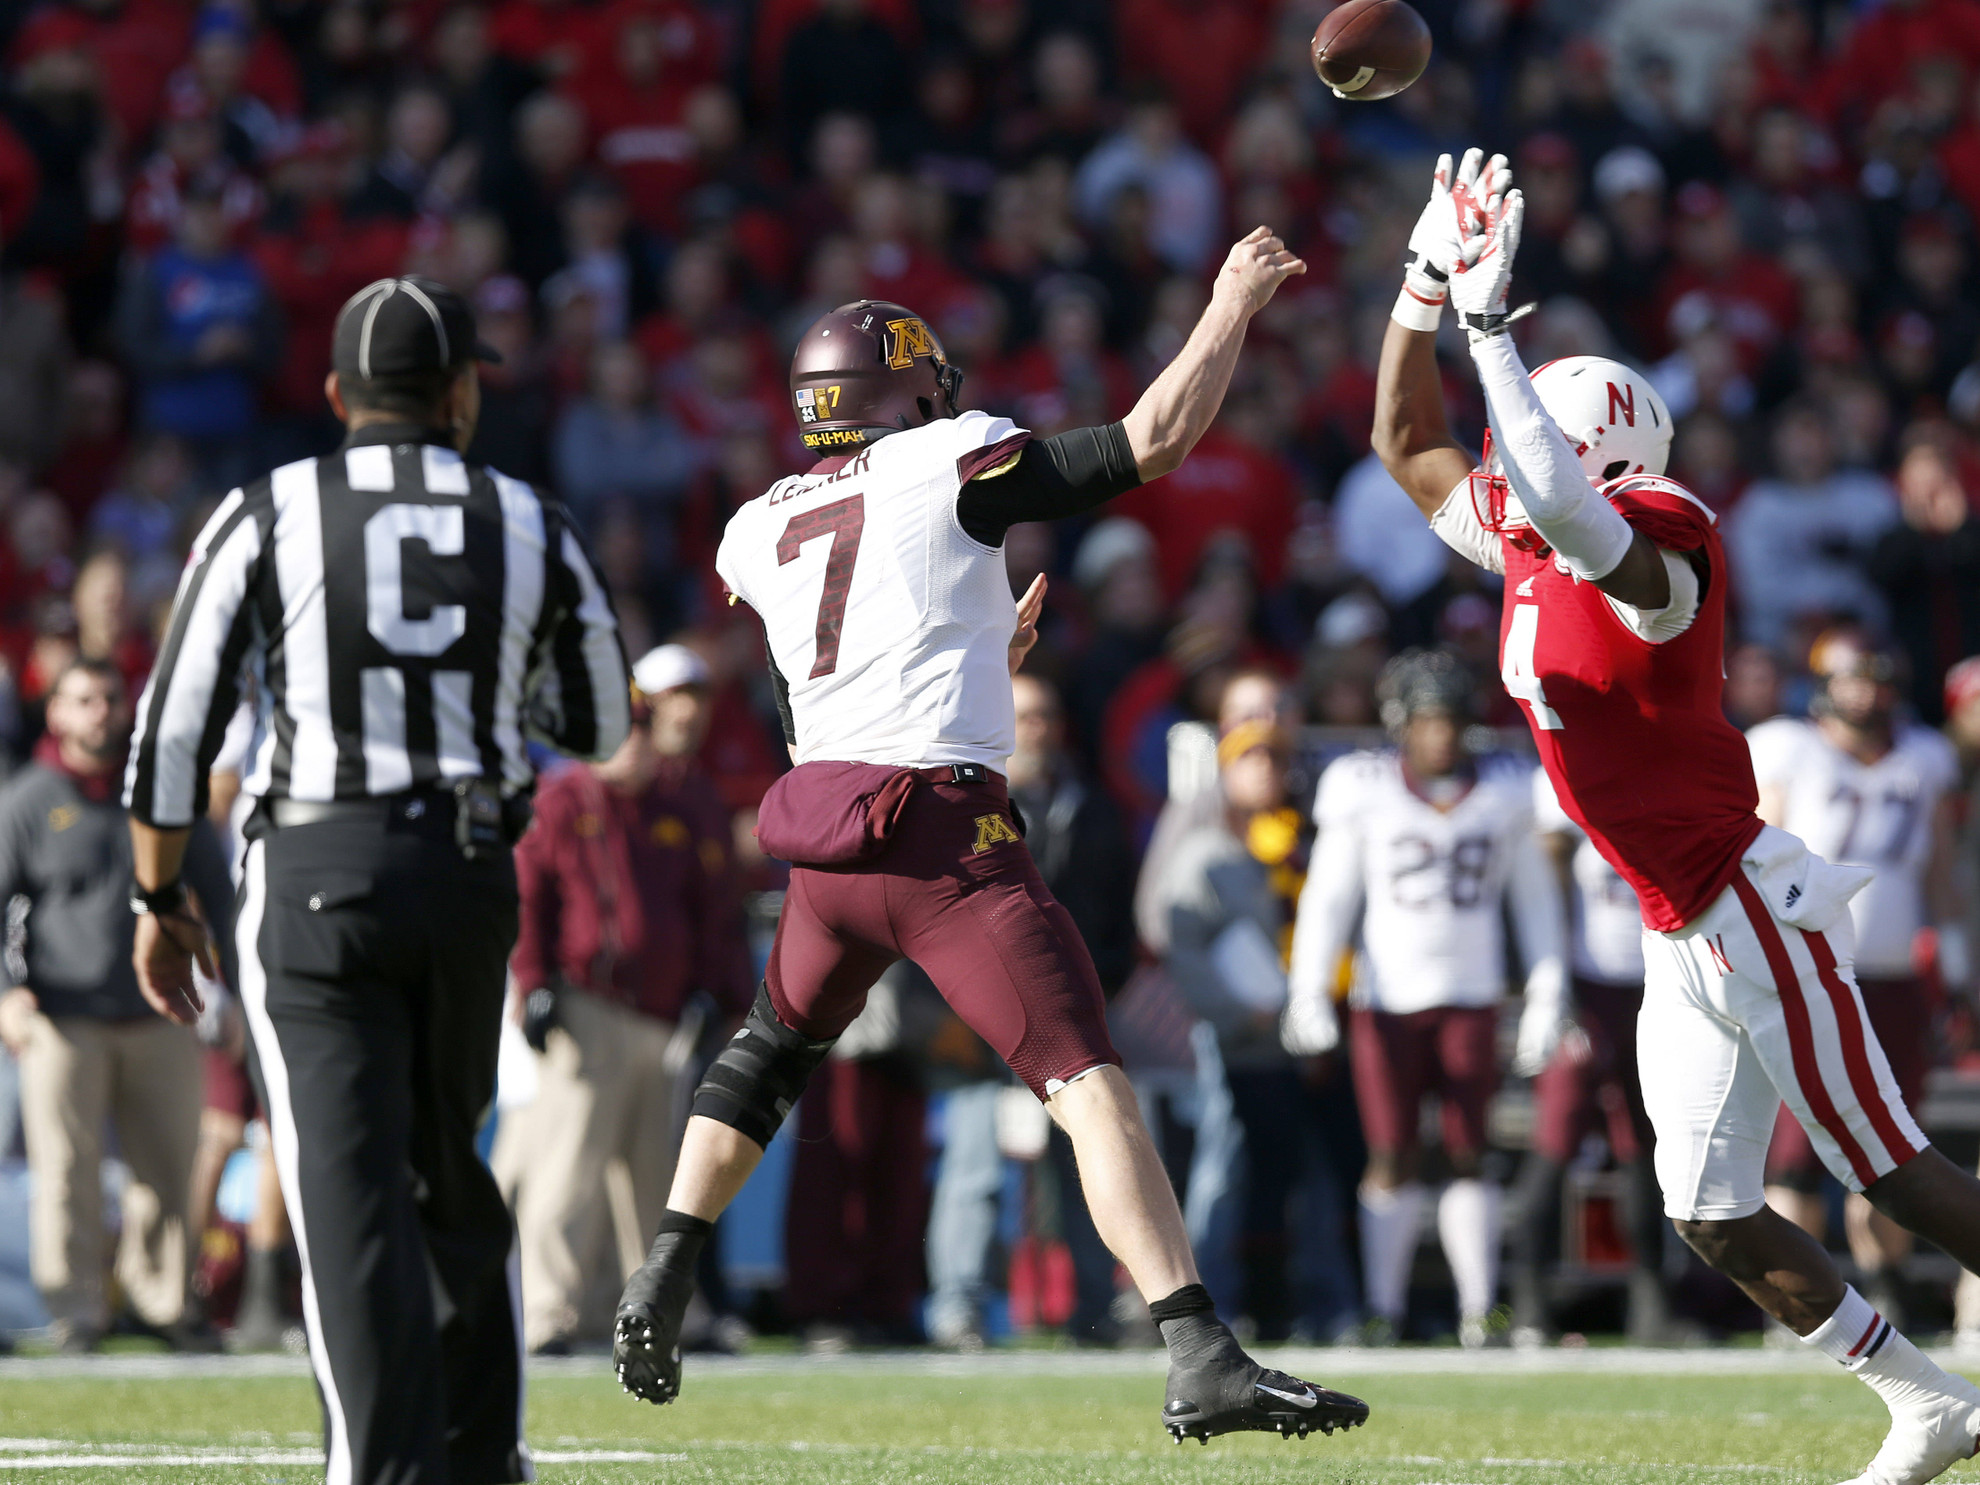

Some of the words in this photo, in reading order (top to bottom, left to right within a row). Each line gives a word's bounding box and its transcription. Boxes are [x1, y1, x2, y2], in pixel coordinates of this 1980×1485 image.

[886, 317, 946, 370] M
[827, 386, 841, 408] 7
[1607, 382, 1634, 427] N
[803, 430, 866, 447] SKI-U-MAH
[363, 503, 467, 657] C
[776, 492, 865, 681] 7
[1502, 603, 1565, 730] 4
[972, 813, 1019, 855] M
[1706, 933, 1735, 977] N
